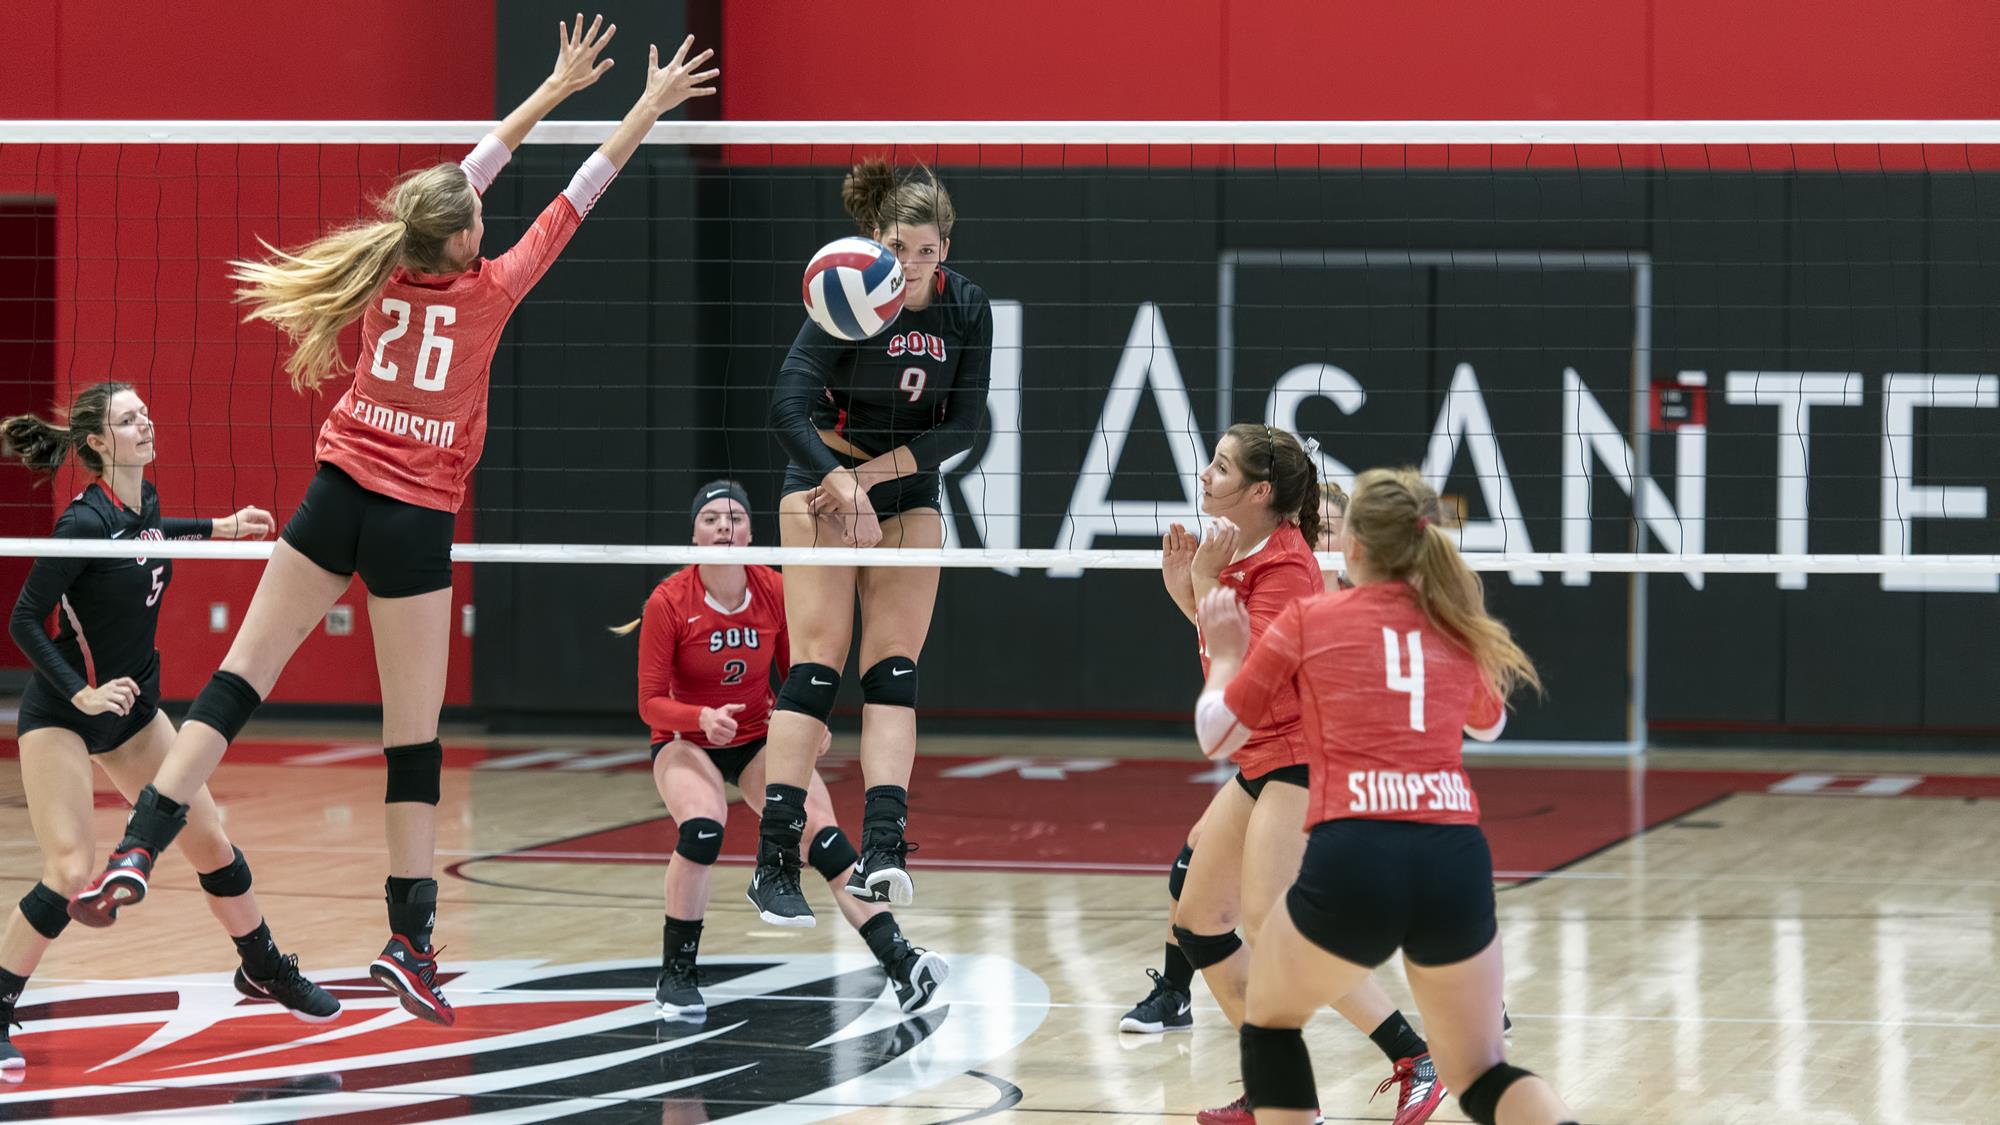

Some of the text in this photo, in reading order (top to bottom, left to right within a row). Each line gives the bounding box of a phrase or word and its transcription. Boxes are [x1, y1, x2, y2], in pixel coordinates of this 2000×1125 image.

[371, 298, 456, 391] 26
[887, 331, 946, 362] SOU
[900, 367, 926, 402] 9
[145, 565, 164, 607] 5
[709, 626, 759, 653] SOU
[720, 659, 747, 685] 2
[1382, 626, 1425, 733] 4
[1348, 769, 1472, 812] SIMPSON
